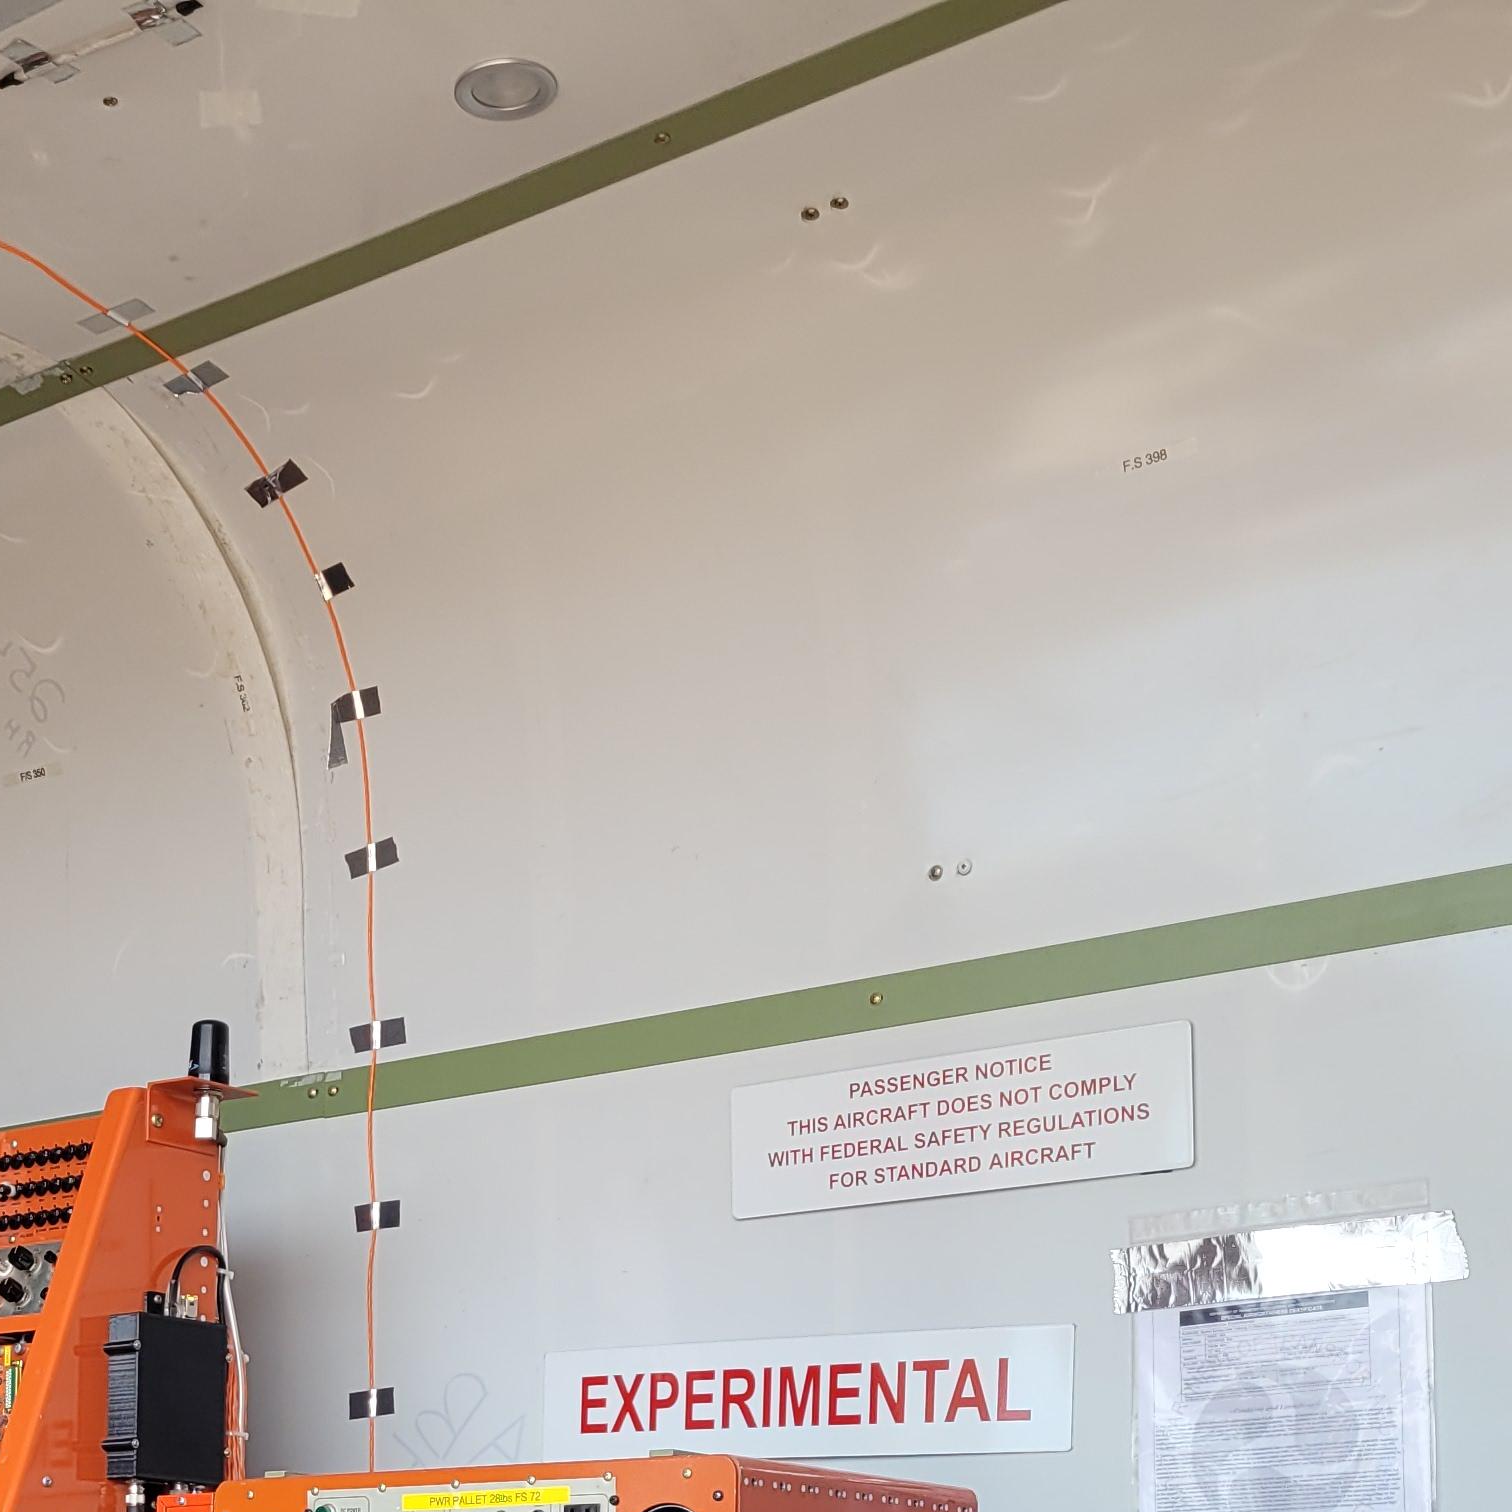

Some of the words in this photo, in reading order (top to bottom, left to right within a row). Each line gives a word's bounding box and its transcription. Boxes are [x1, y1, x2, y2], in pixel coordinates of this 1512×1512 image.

[1145, 448, 1168, 465] 398
[849, 1066, 969, 1099] PASSENGER
[975, 1053, 1053, 1081] NOTICE
[787, 1116, 829, 1137] THIS
[833, 1101, 931, 1130] AIRCRAFT
[937, 1093, 992, 1117] DOES
[999, 1086, 1042, 1108] NOT
[1048, 1072, 1138, 1101] COMPLY
[767, 1147, 814, 1168] WITH
[820, 1135, 909, 1162] FEDERAL
[914, 1122, 993, 1149] SAFETY
[998, 1102, 1150, 1139] REGULATIONS
[829, 1169, 868, 1190] FOR
[873, 1156, 982, 1184] STANDARD
[988, 1141, 1097, 1171] AIRCRAFT
[579, 1356, 1032, 1435] EXPERIMENTAL
[429, 1496, 451, 1506] PWR
[452, 1494, 487, 1506] PALLET
[515, 1492, 528, 1502] FS
[530, 1491, 541, 1501] 72
